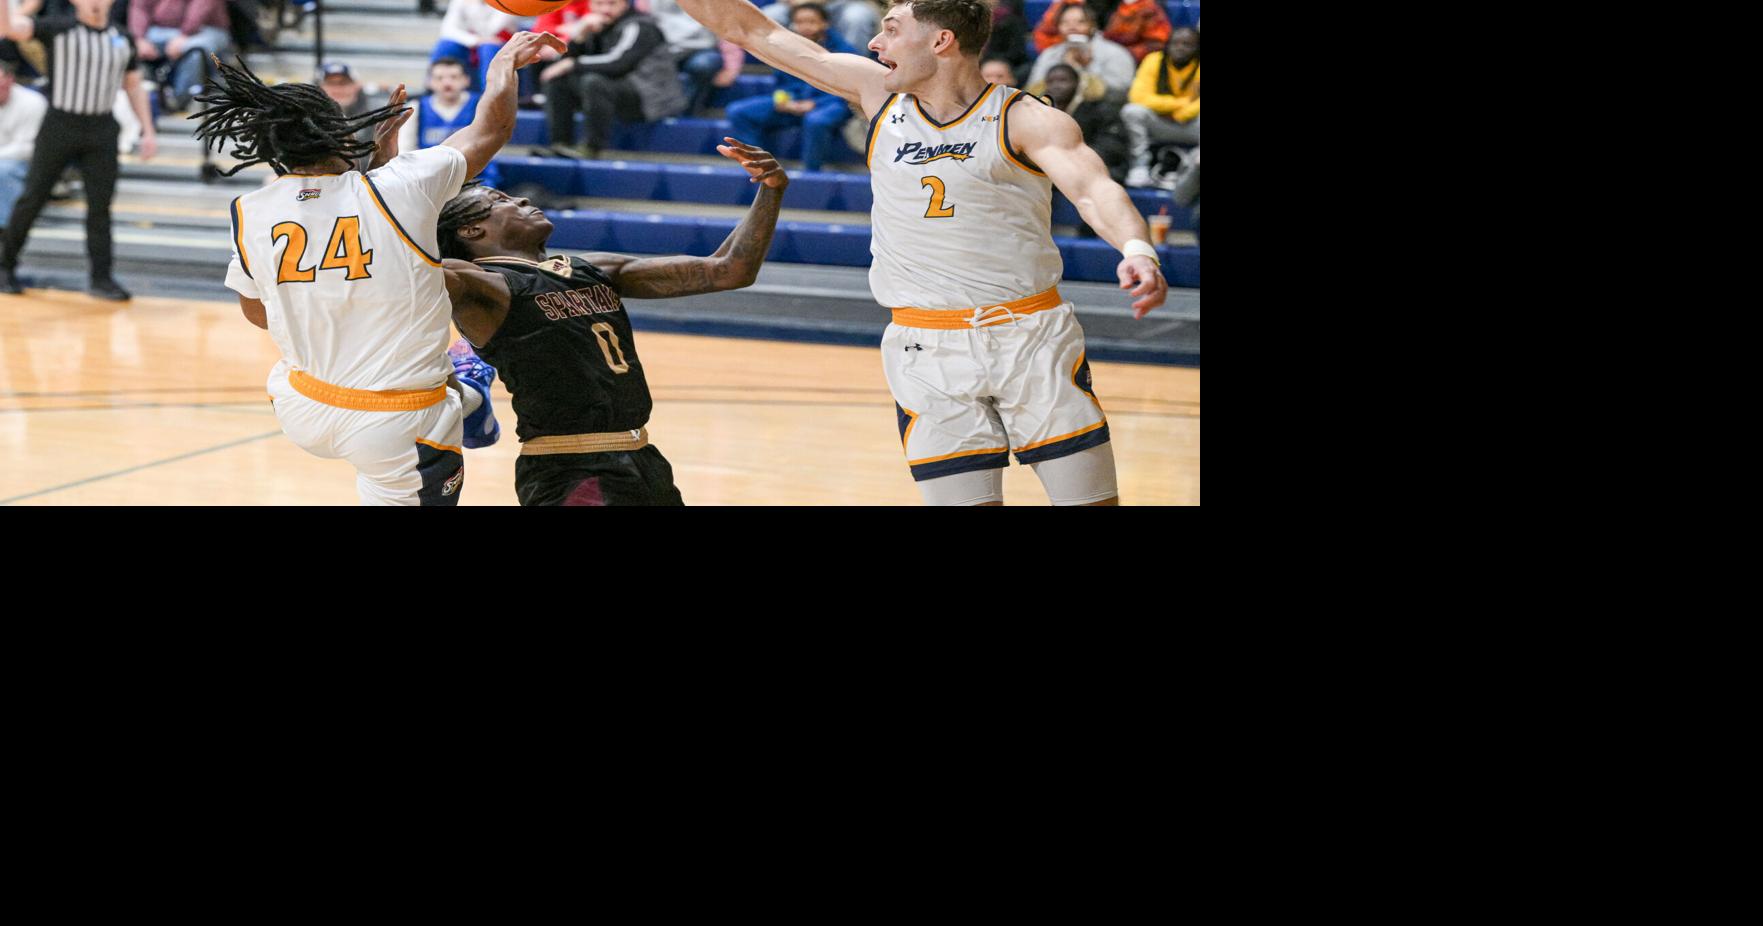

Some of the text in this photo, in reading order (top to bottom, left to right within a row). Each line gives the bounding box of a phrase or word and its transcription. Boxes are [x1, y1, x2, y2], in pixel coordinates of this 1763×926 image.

[920, 175, 955, 218] 2
[271, 215, 373, 285] 24
[591, 321, 630, 374] 0
